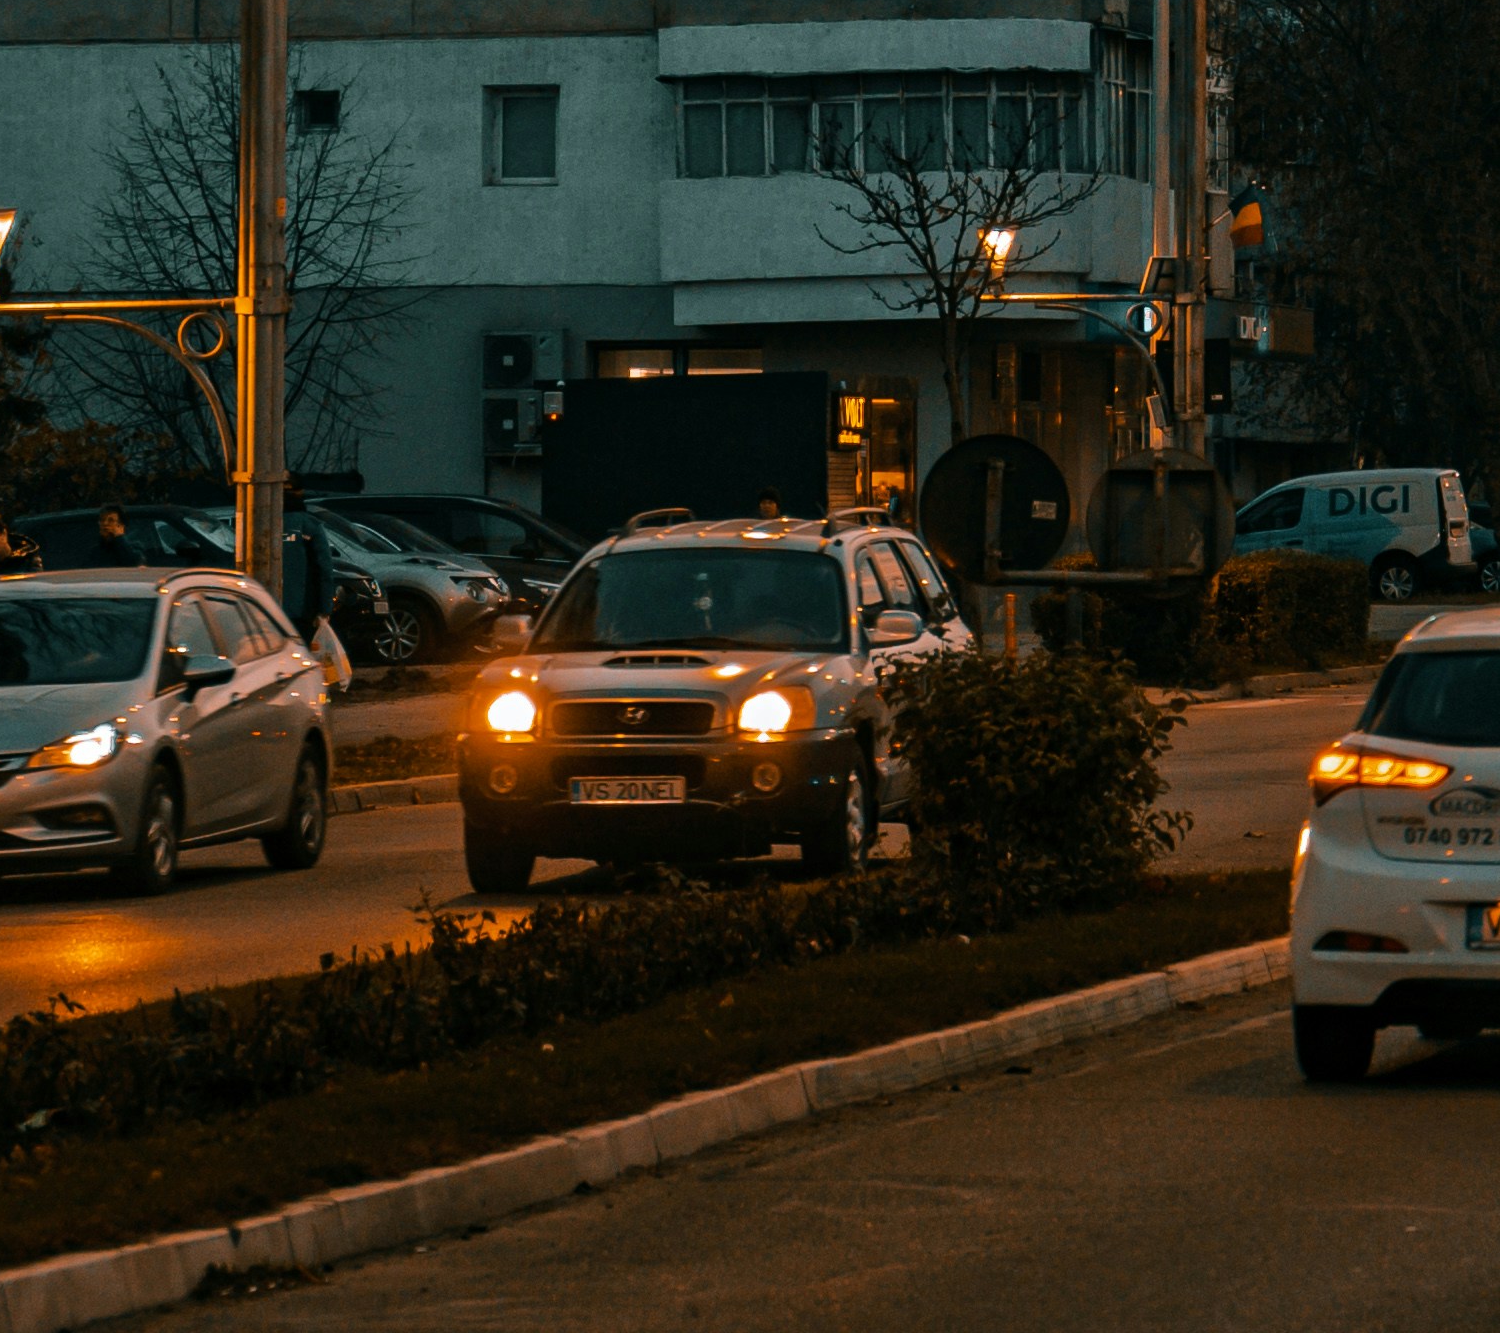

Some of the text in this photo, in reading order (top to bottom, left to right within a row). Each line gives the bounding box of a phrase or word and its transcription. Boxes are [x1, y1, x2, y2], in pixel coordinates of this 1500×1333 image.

[1329, 485, 1409, 516] DIGI
[582, 782, 609, 800] VS
[1404, 826, 1451, 845] 0740
[1457, 827, 1495, 845] 972
